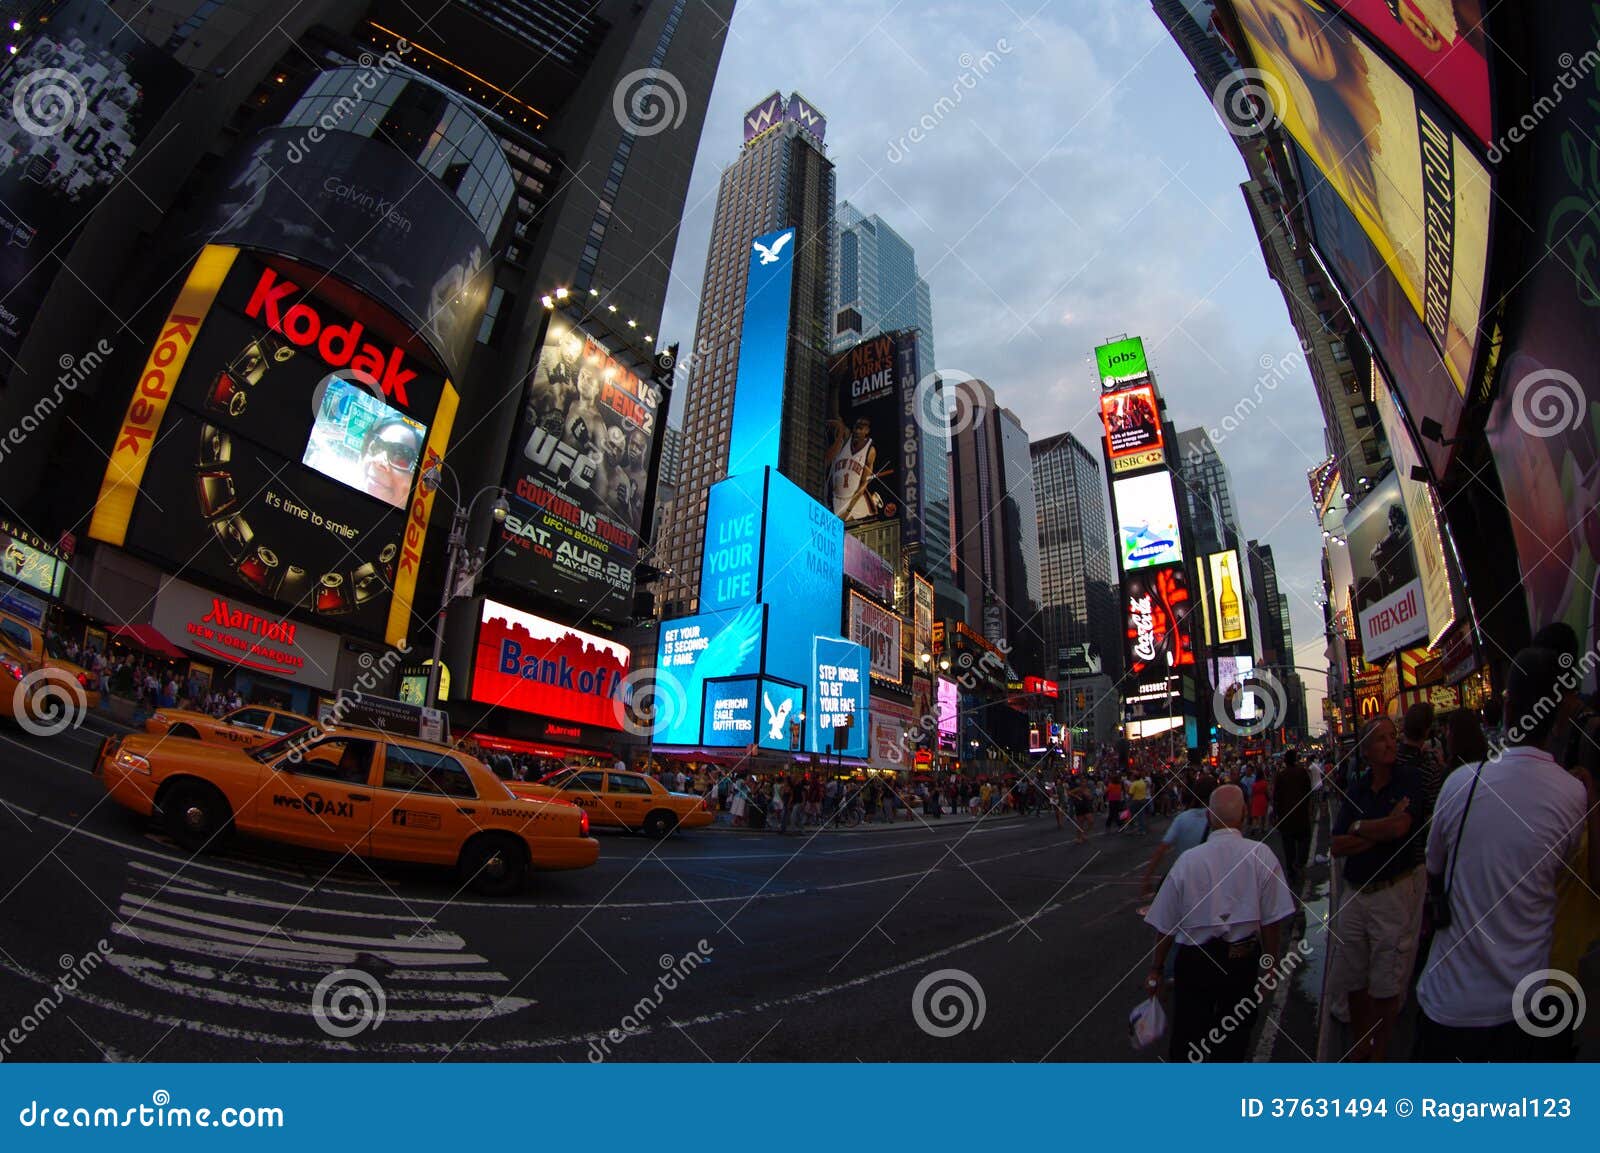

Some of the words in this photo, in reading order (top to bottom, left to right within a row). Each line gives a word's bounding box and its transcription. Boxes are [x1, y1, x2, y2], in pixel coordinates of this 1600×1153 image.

[748, 100, 776, 132] W
[799, 102, 819, 126] W
[323, 177, 376, 210] Calvin
[370, 197, 412, 234] Klein
[245, 267, 418, 406] Kodak
[852, 336, 891, 367] NEW
[1107, 351, 1137, 368] jobs
[117, 314, 201, 457] Kodak
[852, 368, 893, 398] GAME
[901, 349, 915, 416] TIMES
[524, 427, 596, 490] UFC
[903, 424, 919, 521] SQUARE
[1114, 455, 1145, 470] HSBC
[265, 491, 281, 507] it's
[283, 498, 309, 519] time
[311, 508, 324, 526] to
[515, 478, 581, 524] COUTURE
[580, 509, 597, 533] VS
[808, 502, 839, 537] LEAVE
[501, 529, 531, 551] LIVE
[534, 543, 553, 560] ON
[504, 515, 553, 549] SAT.
[543, 515, 563, 532] UFC
[574, 530, 609, 554] BOXING
[719, 513, 754, 545] LIVE
[809, 528, 837, 560] YOUR
[708, 543, 753, 576] YOUR
[807, 553, 836, 583] MARK
[717, 574, 751, 602] LIFE
[203, 597, 297, 647] Marriott
[1368, 589, 1418, 639] maxell
[187, 622, 214, 641] NEW
[216, 631, 248, 651] YORK
[251, 643, 304, 669] MARQUIS
[664, 642, 673, 655] 15
[674, 637, 709, 653] SECONDS
[665, 629, 679, 642] GET
[680, 626, 700, 640] YOUR
[499, 638, 574, 689] Bank
[578, 666, 607, 696] of
[663, 655, 672, 667] OF
[819, 664, 837, 680] STEP
[838, 667, 859, 683] INSIDE
[714, 698, 748, 710] AMERICAN
[819, 681, 829, 697] TO
[830, 682, 843, 697] GET
[713, 709, 734, 721] EAGLE
[820, 697, 839, 712] YOUR
[840, 698, 855, 713] FACE
[820, 713, 830, 728] UP
[544, 724, 583, 737] Marriott
[713, 719, 752, 731] OUTFITTERS
[273, 794, 302, 810] NYC
